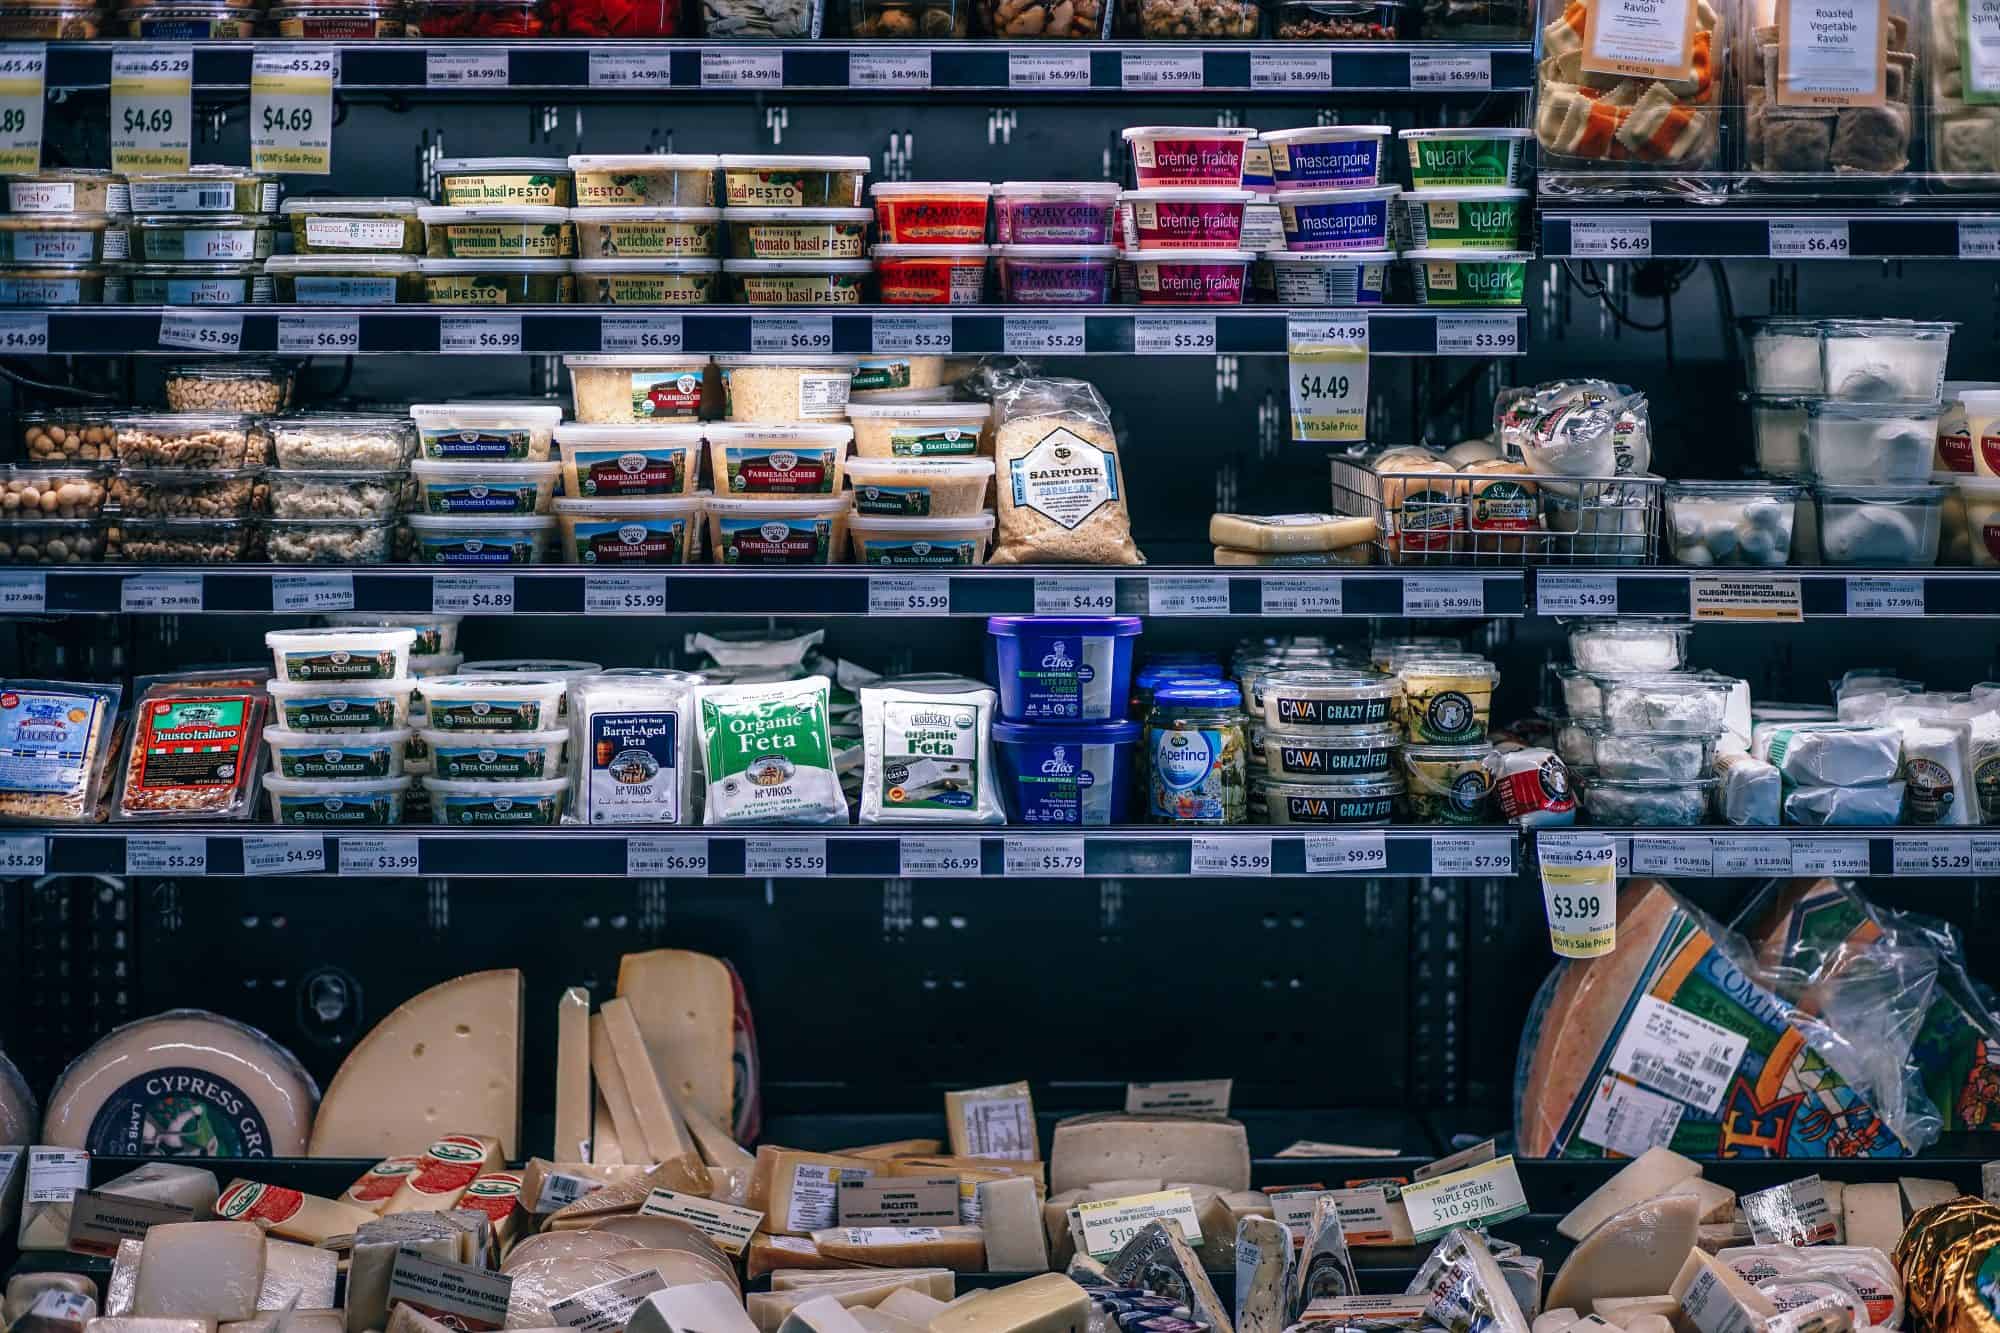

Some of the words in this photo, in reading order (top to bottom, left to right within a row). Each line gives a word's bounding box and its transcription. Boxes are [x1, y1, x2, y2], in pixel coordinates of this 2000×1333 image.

[1624, 2, 1657, 14] Ravioli
[1816, 8, 1853, 19] Roasted
[1809, 22, 1857, 33] Vegetable
[1817, 34, 1848, 44] Ravioli
[151, 60, 189, 72] $5.29
[293, 59, 330, 71] $5.29
[631, 70, 670, 79] $4.99/lb
[1049, 71, 1089, 80] $6.99/lb
[1161, 71, 1201, 80] $5.99/lb
[1290, 71, 1330, 80] $8.99/lb
[1450, 71, 1489, 80] $6.99/lb
[124, 105, 173, 134] $4.69
[263, 105, 313, 133] $4.69
[145, 153, 163, 164] Sale
[164, 153, 183, 165] Price
[283, 153, 301, 164] Sale
[302, 153, 322, 164] Price
[1158, 151, 1198, 166] crème
[1202, 150, 1239, 166] fraîche
[1296, 153, 1370, 171] mascarpone
[1426, 143, 1476, 170] quark
[484, 183, 506, 197] basil
[508, 186, 550, 197] PESTO
[588, 186, 624, 196] PESTO
[748, 186, 794, 198] PESTO
[17, 192, 50, 205] pesto
[1160, 213, 1200, 228] crème
[1204, 212, 1240, 228] fraîche
[1302, 214, 1378, 232] mascarpone
[1470, 207, 1513, 232] quark
[34, 241, 75, 255] pesto
[207, 240, 243, 254] pesto
[453, 235, 497, 250] premium
[500, 234, 523, 248] basil
[525, 237, 556, 248] PESTO
[616, 235, 663, 248] artichoke
[666, 239, 702, 247] PESTO
[755, 237, 790, 251] tomato
[794, 236, 820, 250] basil
[822, 240, 859, 249] PESTO
[1610, 237, 1649, 250] $6.49
[1808, 238, 1847, 251] $6.49
[1161, 275, 1201, 289] crème
[1206, 275, 1240, 289] fraîche
[1467, 269, 1514, 293] quark
[16, 288, 58, 301] pesto
[191, 290, 230, 303] pesto
[454, 288, 497, 299] PESTO
[615, 288, 662, 301] artichoke
[664, 290, 701, 300] PESTO
[749, 289, 785, 303] tomato
[786, 288, 812, 302] basil
[815, 290, 856, 301] PESTO
[199, 328, 240, 344] $5.99
[1328, 326, 1366, 339] $4.99
[7, 333, 46, 346] $4.99
[317, 333, 357, 346] $6.99
[479, 333, 520, 346] $6.99
[641, 333, 681, 347] $6.99
[791, 333, 831, 347] $6.99
[914, 334, 951, 346] $5.29
[1047, 335, 1083, 347] $5.29
[1174, 334, 1215, 347] $5.29
[1476, 333, 1516, 347] $3.99
[1300, 375, 1349, 401] $4.49
[1320, 421, 1338, 432] Sale
[1339, 421, 1358, 432] Price
[1945, 439, 1967, 449] Fresh
[598, 473, 639, 481] PARMESAN
[640, 472, 668, 480] CHEESE
[748, 469, 788, 478] PARMESAN
[1030, 467, 1099, 480] SARTORI
[598, 544, 639, 552] PARMESAN
[640, 543, 666, 551] CHEESE
[741, 541, 779, 549] PARMESAN
[472, 593, 513, 607] $4.89
[624, 593, 664, 607] $5.99
[908, 595, 948, 609] $5.99
[1073, 595, 1114, 609] $4.49
[1190, 594, 1228, 605] $10.99/lb
[1301, 597, 1340, 606] $11.79/lb
[1442, 599, 1482, 608] $8.99/lb
[1579, 593, 1615, 606] $4.99
[1886, 598, 1925, 608] $7.99/lb
[312, 664, 331, 673] FETA
[332, 664, 371, 673] CRUMBLES
[1281, 700, 1316, 718] CAVA
[1327, 706, 1362, 720] CRAZY
[1366, 704, 1385, 718] FETA
[311, 713, 328, 721] FETA
[330, 713, 369, 721] CRUMBLES
[454, 716, 472, 724] FETA
[472, 716, 512, 724] CRUMBLES
[913, 714, 950, 727] ROUSSAS
[729, 712, 803, 736] Organic
[602, 724, 666, 739] Barrel-Aged
[904, 728, 957, 741] organic
[622, 736, 646, 747] Feta
[739, 733, 797, 753] Feta
[907, 739, 955, 756] Feta
[1159, 746, 1209, 766] Apetina
[1285, 750, 1321, 768] CAVA
[1332, 754, 1368, 768] CRAZY
[1370, 753, 1388, 767] FETA
[324, 763, 364, 771] CRUMBLES
[479, 764, 519, 772] CRUMBLES
[626, 784, 653, 796] VIKOS
[766, 784, 793, 798] VIKOS
[1292, 798, 1329, 816] CAVA
[1340, 802, 1374, 817] CRAZY
[7, 854, 43, 867] $5.29
[287, 849, 323, 863] $4.99
[1347, 849, 1384, 862] $9.99
[1576, 848, 1613, 861] $4.49
[168, 855, 204, 868] $5.29
[378, 855, 418, 869] $3.99
[667, 855, 706, 869] $6.99
[785, 856, 825, 870] $5.59
[943, 857, 979, 870] $6.99
[1042, 855, 1083, 869] $5.79
[1230, 855, 1270, 868] $5.99
[1475, 855, 1511, 868] $7.99
[1931, 855, 1970, 869] $5.29
[1553, 893, 1600, 919] $3.99
[1575, 939, 1592, 950] Sale
[1592, 936, 1612, 947] Price
[146, 1075, 244, 1116] CYPRESS
[128, 1102, 144, 1142] LAMB
[1431, 1190, 1463, 1206] TRIPLE
[1432, 1195, 1499, 1221] $10.99/lb.
[1086, 1218, 1113, 1228] ORGANIC
[1130, 1210, 1166, 1222] MANCHEGO
[1167, 1206, 1193, 1216] CURADO
